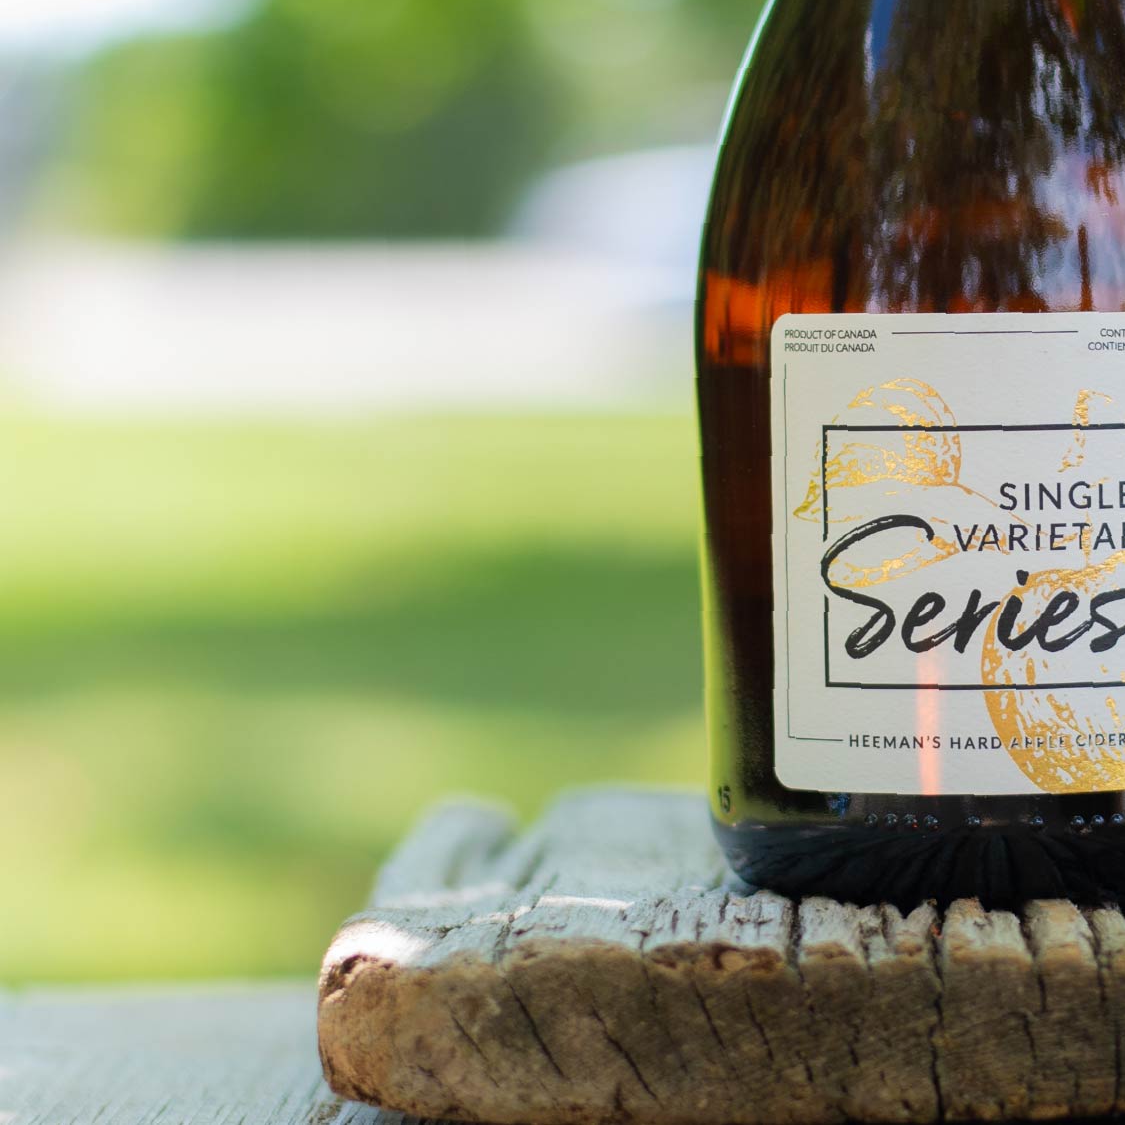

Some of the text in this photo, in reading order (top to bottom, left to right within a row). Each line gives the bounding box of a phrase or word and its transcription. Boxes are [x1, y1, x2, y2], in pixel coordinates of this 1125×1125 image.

[784, 329, 878, 340] PRODUCT OF CANADA
[784, 342, 876, 353] PRODUIT DU CANADA
[849, 734, 941, 749] HEEMAN'S
[949, 736, 1002, 750] HARD
